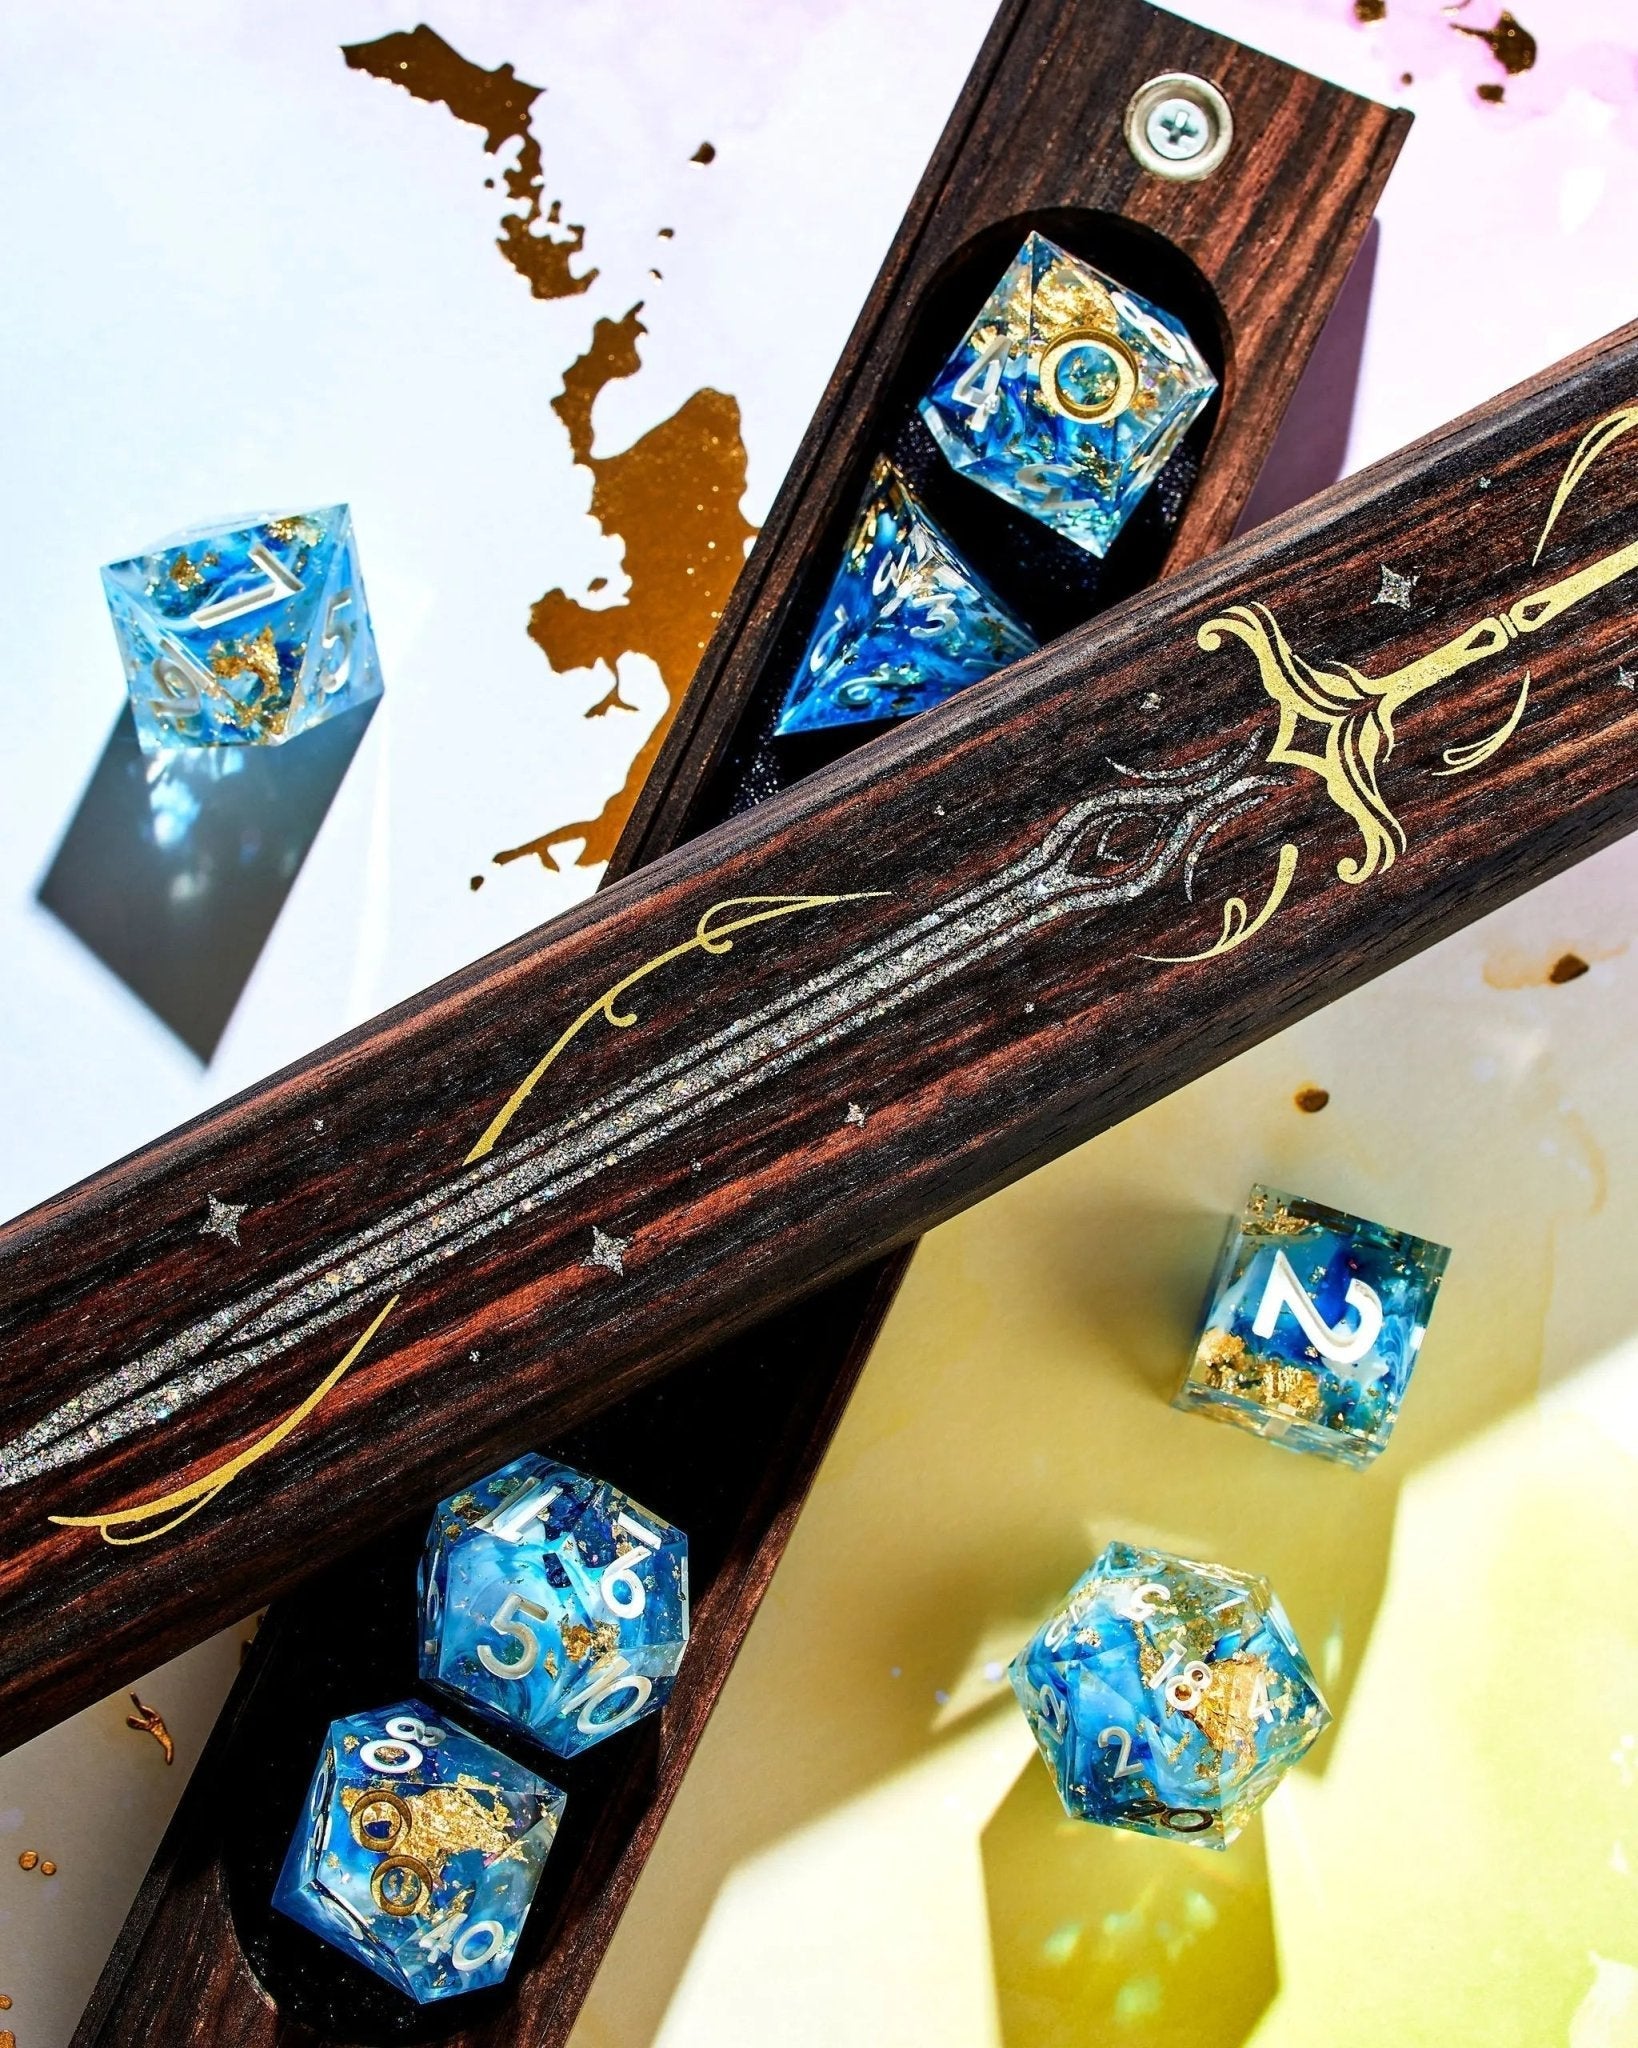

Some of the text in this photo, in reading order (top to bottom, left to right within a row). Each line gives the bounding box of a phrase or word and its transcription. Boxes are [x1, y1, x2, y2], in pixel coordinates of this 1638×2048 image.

[1110, 291, 1188, 364] 8
[951, 333, 1013, 433] 4
[908, 593, 960, 638] 3
[1252, 1249, 1383, 1365] 2
[477, 1592, 550, 1680] 5
[561, 1655, 652, 1735] 10
[1149, 1639, 1213, 1711] 18
[1249, 1671, 1274, 1723] 4
[1098, 1726, 1143, 1778] 2
[419, 1912, 504, 1972] 40
